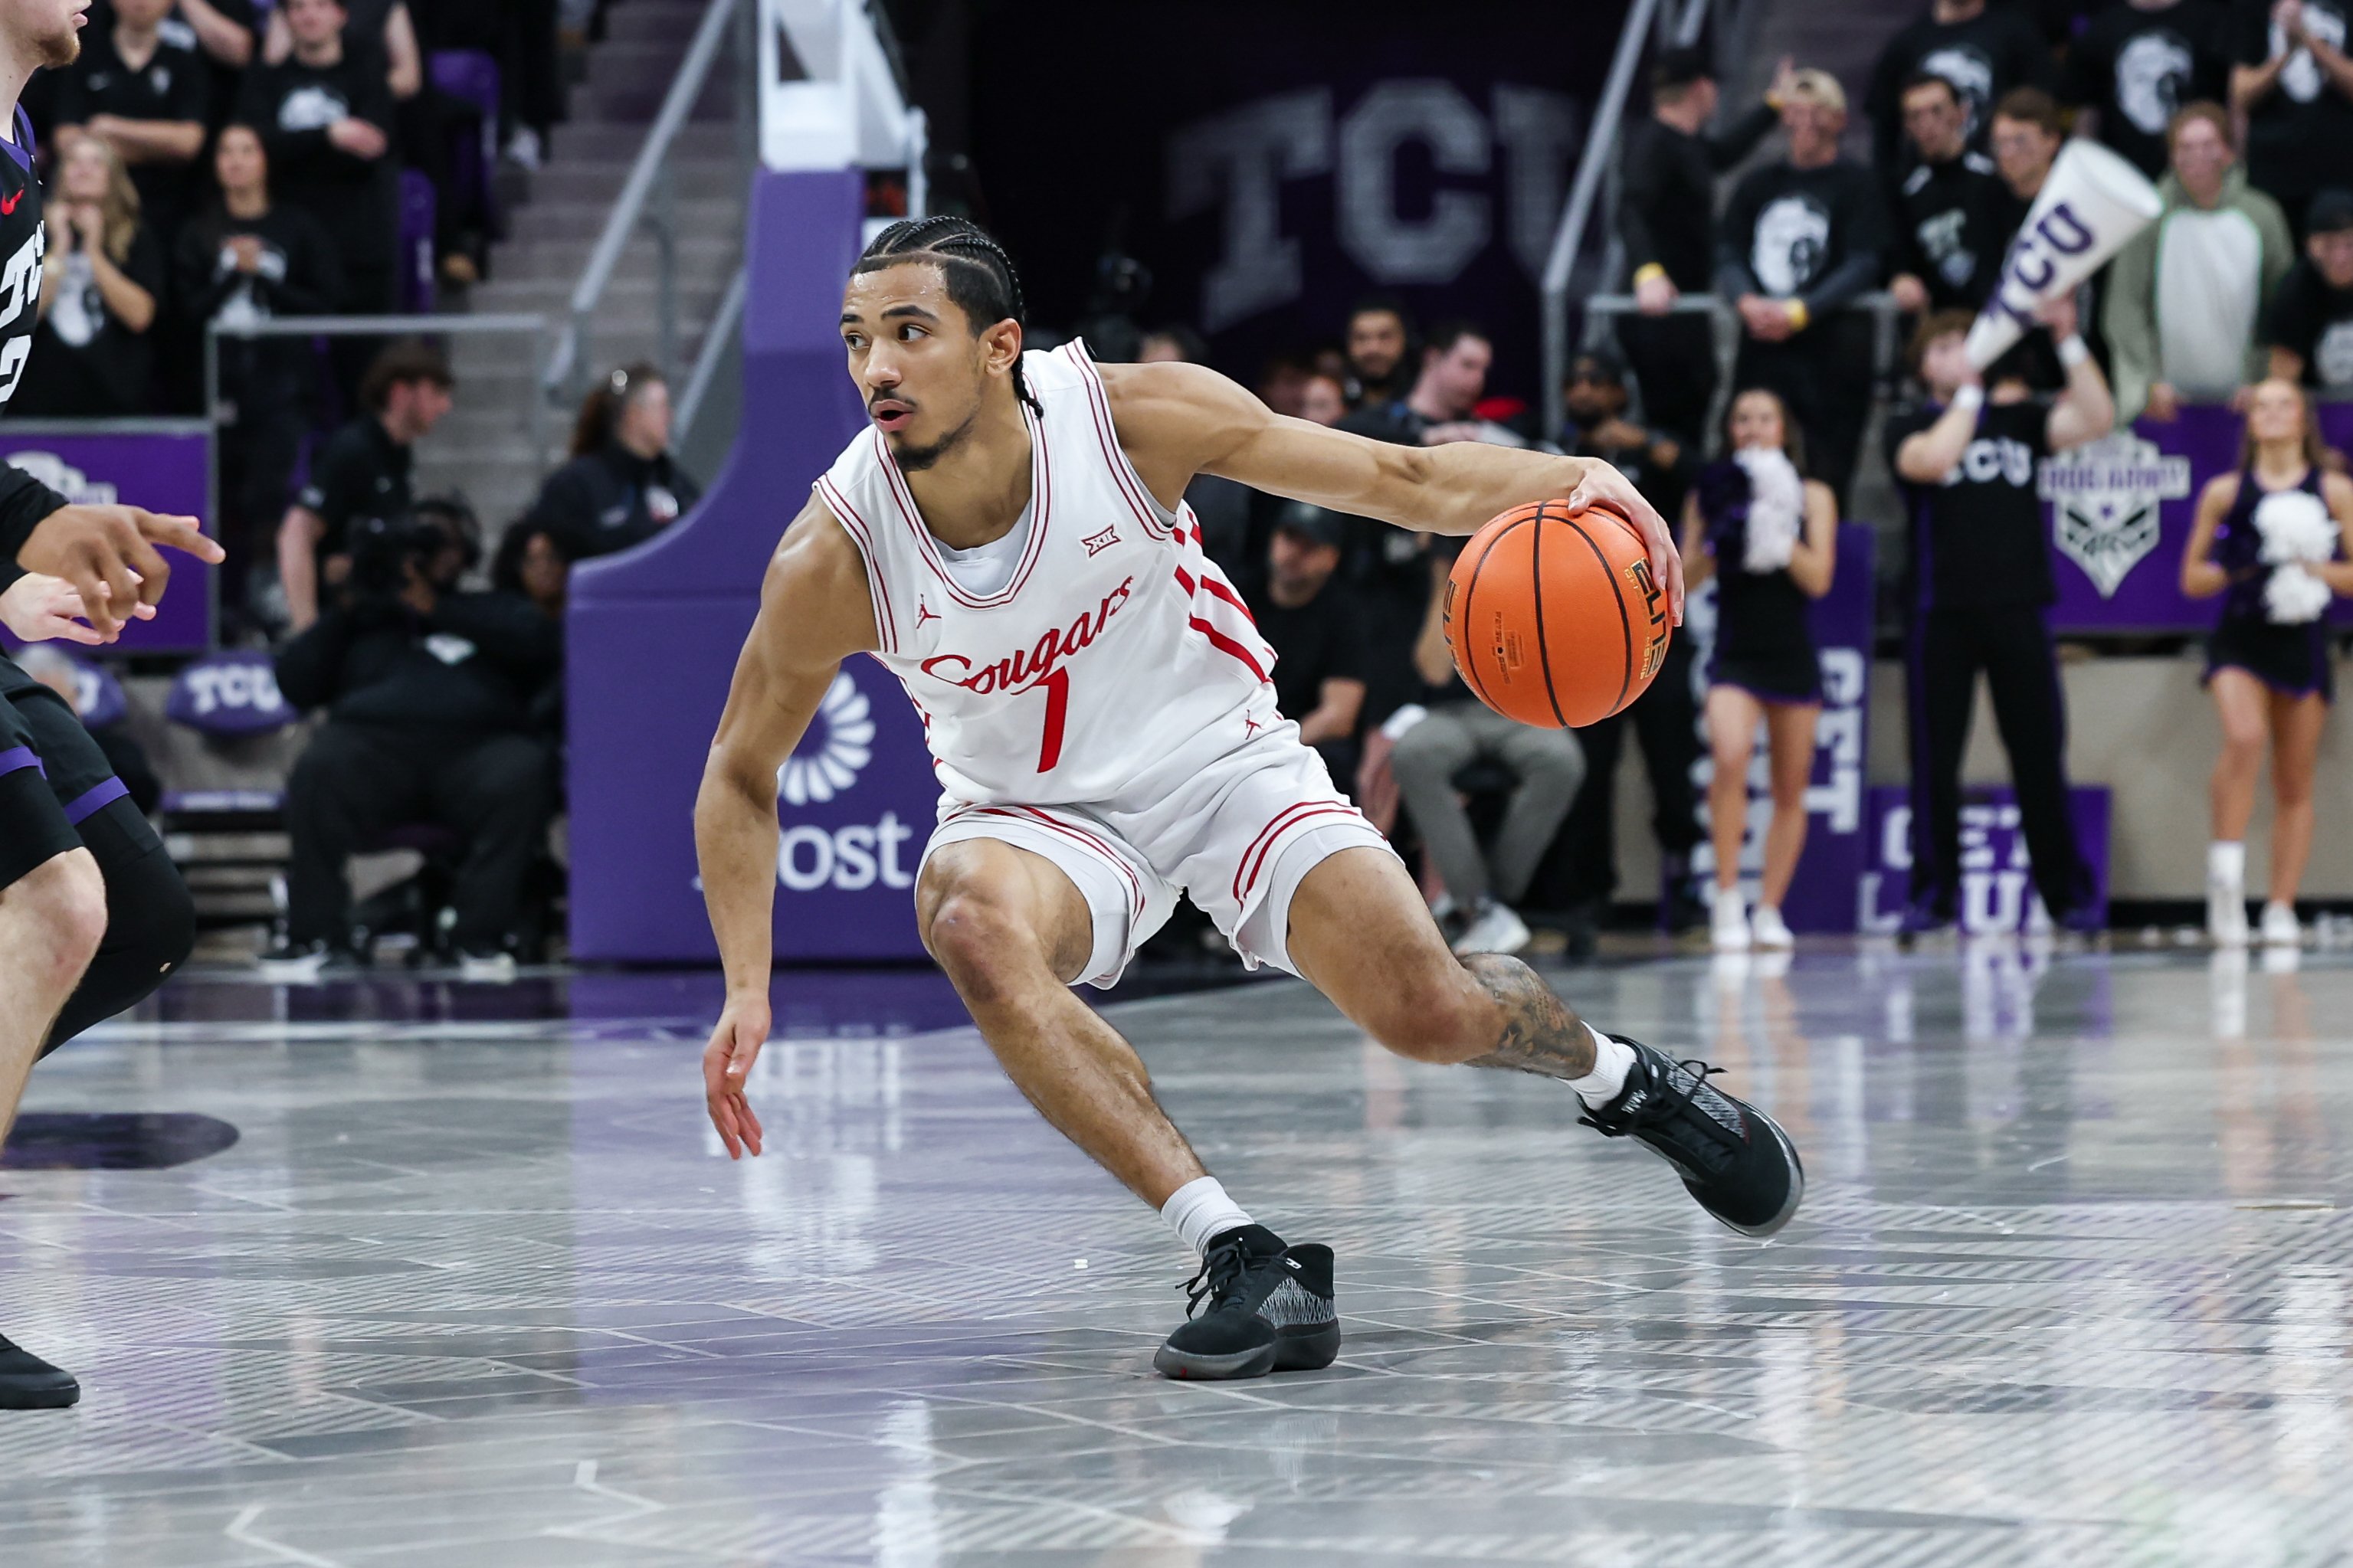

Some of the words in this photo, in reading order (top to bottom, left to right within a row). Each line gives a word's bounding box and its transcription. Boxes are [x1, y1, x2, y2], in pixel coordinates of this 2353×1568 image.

[1945, 437, 2033, 487] CU
[921, 576, 1132, 695] Cougars
[188, 665, 282, 714] TCU
[693, 811, 914, 891] ost
